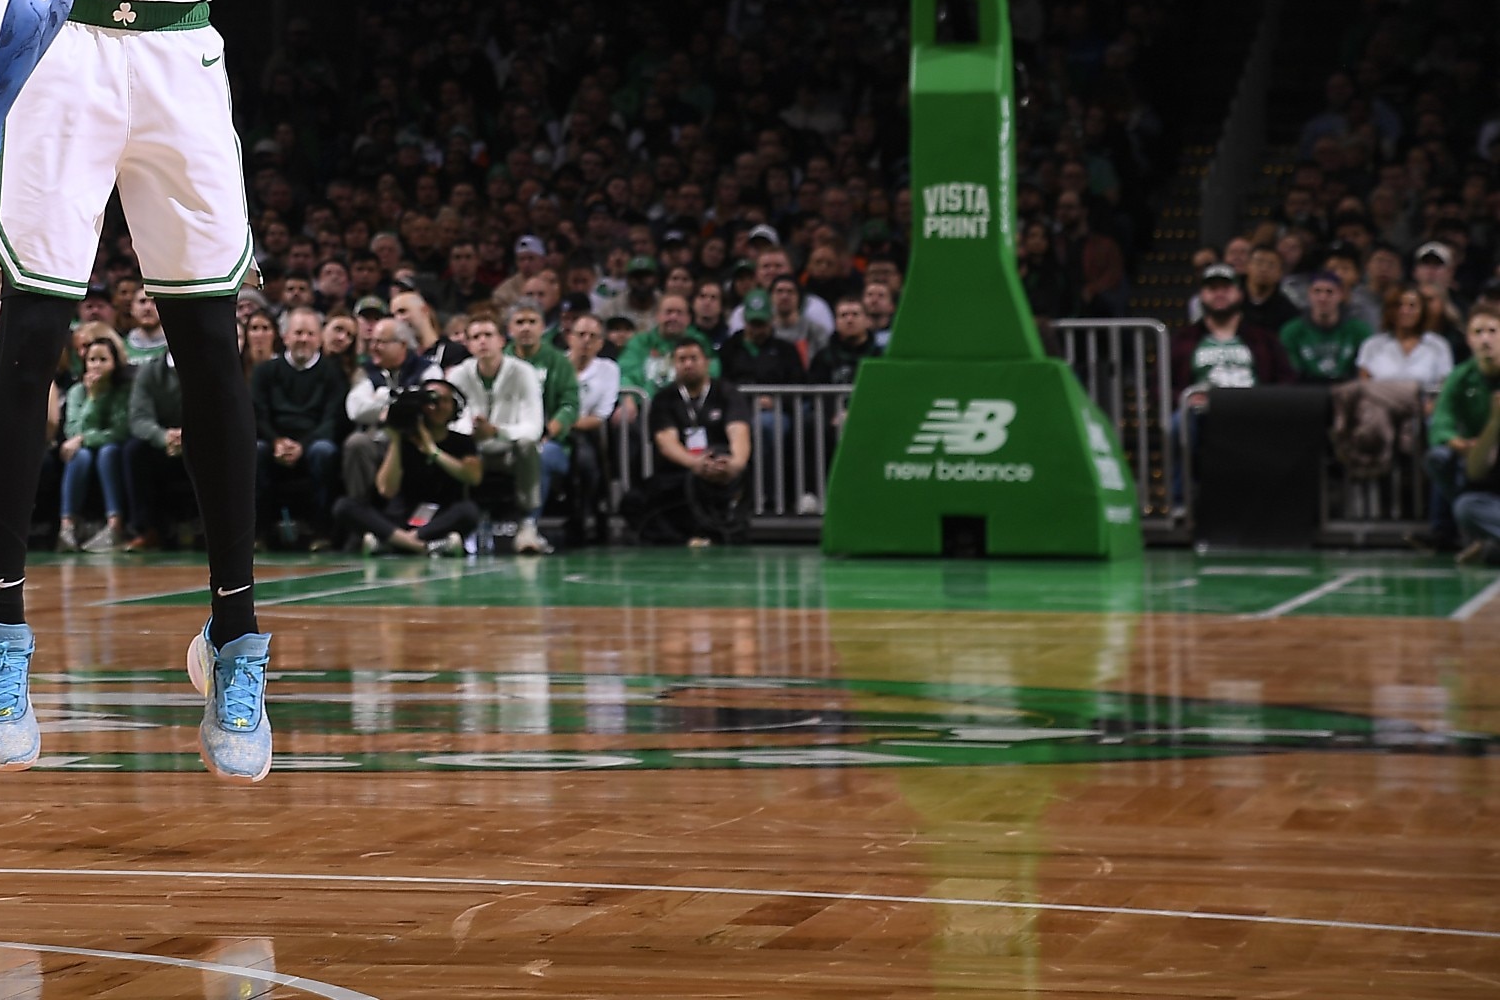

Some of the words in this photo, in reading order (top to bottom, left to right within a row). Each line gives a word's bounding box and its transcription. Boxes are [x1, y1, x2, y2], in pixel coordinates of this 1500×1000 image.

[923, 182, 990, 215] VISTA
[924, 216, 988, 239] PRINT
[884, 461, 933, 480] new
[935, 459, 1034, 482] balance
